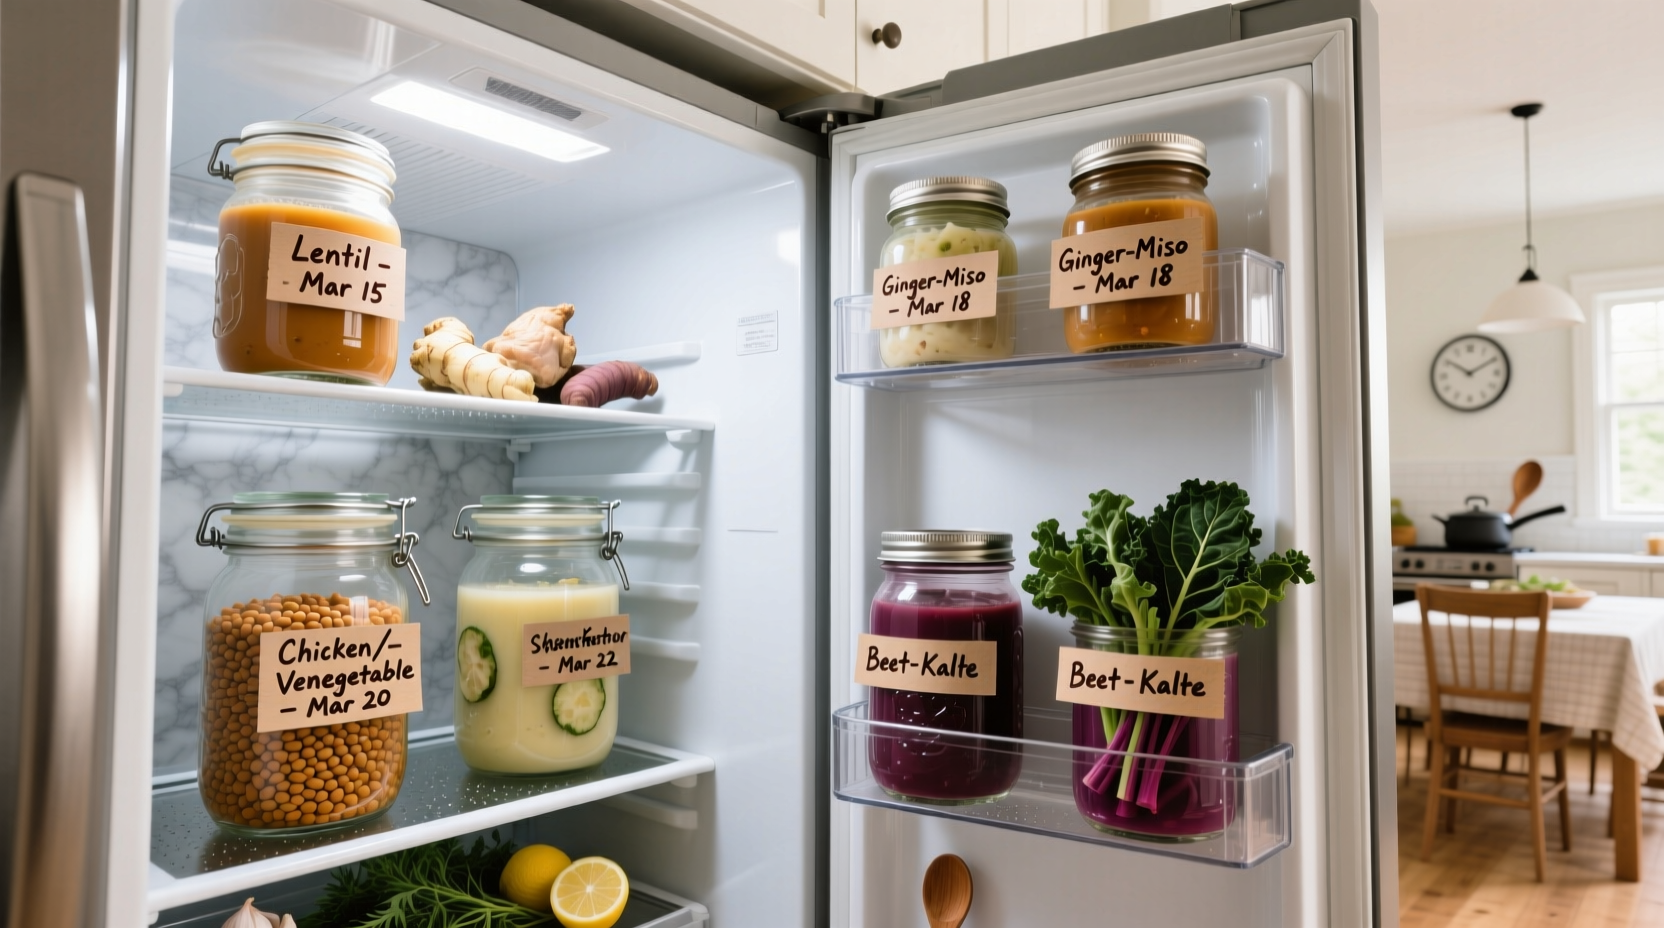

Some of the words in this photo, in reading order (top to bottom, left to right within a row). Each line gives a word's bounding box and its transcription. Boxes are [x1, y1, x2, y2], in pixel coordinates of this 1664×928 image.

[291, 233, 371, 271] Lentil
[1058, 235, 1189, 277] Ginger-Miso
[298, 270, 353, 298] Mar
[361, 280, 387, 304] 15
[882, 266, 986, 300] Ginger-Miso
[1094, 271, 1140, 294] Mar
[1149, 262, 1174, 288] 18
[906, 296, 945, 318] Mar
[951, 290, 971, 312] 18
[276, 658, 415, 698] Venegetable
[557, 655, 592, 674] Mar
[595, 650, 619, 669] 22
[866, 645, 979, 679] Beet-Kalte
[306, 695, 355, 718] Mar
[361, 688, 391, 711] 20
